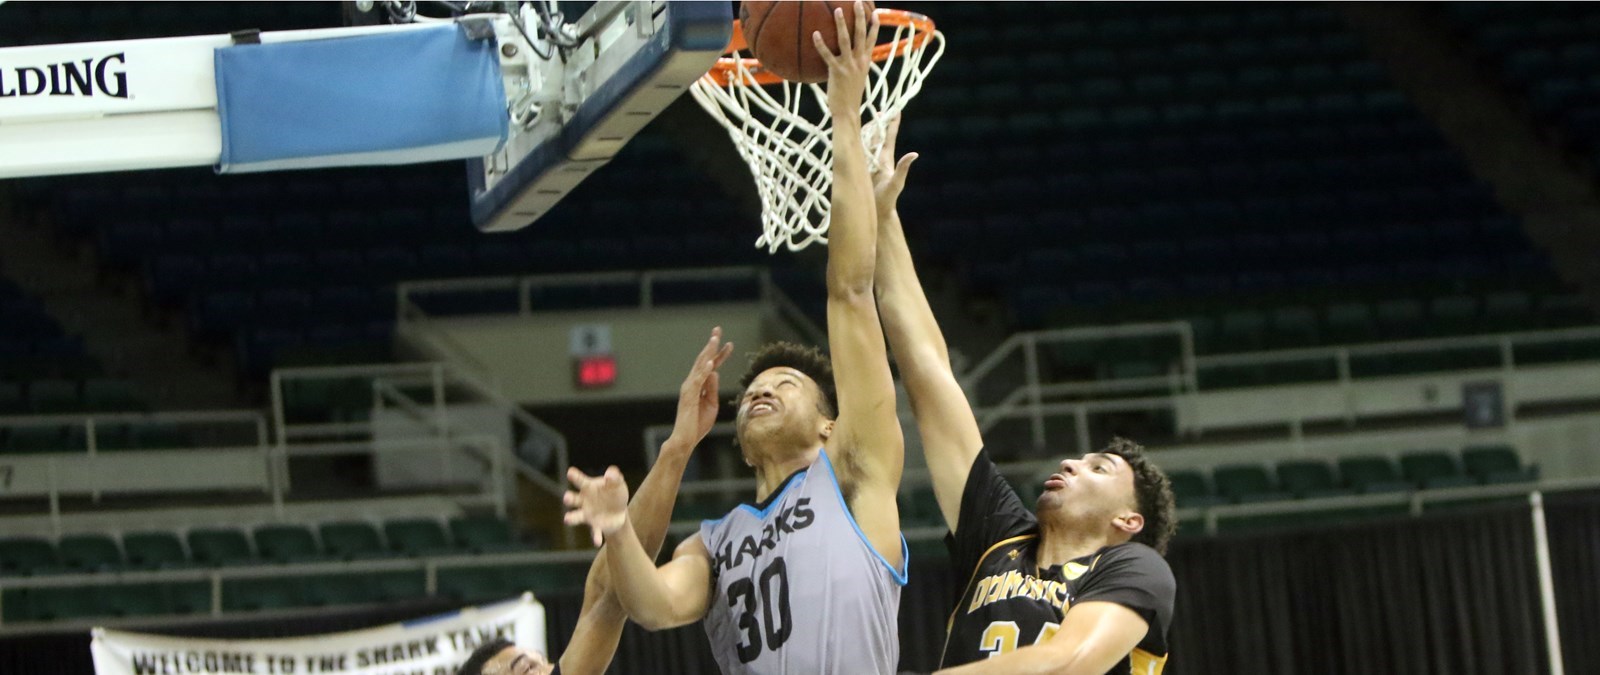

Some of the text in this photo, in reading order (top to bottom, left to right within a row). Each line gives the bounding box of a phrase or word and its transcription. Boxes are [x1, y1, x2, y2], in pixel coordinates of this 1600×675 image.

[710, 497, 815, 577] HARKS
[727, 556, 792, 665] 30
[132, 652, 255, 675] WELCOME
[265, 655, 296, 674] TO
[305, 652, 348, 673] THE
[356, 636, 439, 667] SHARK
